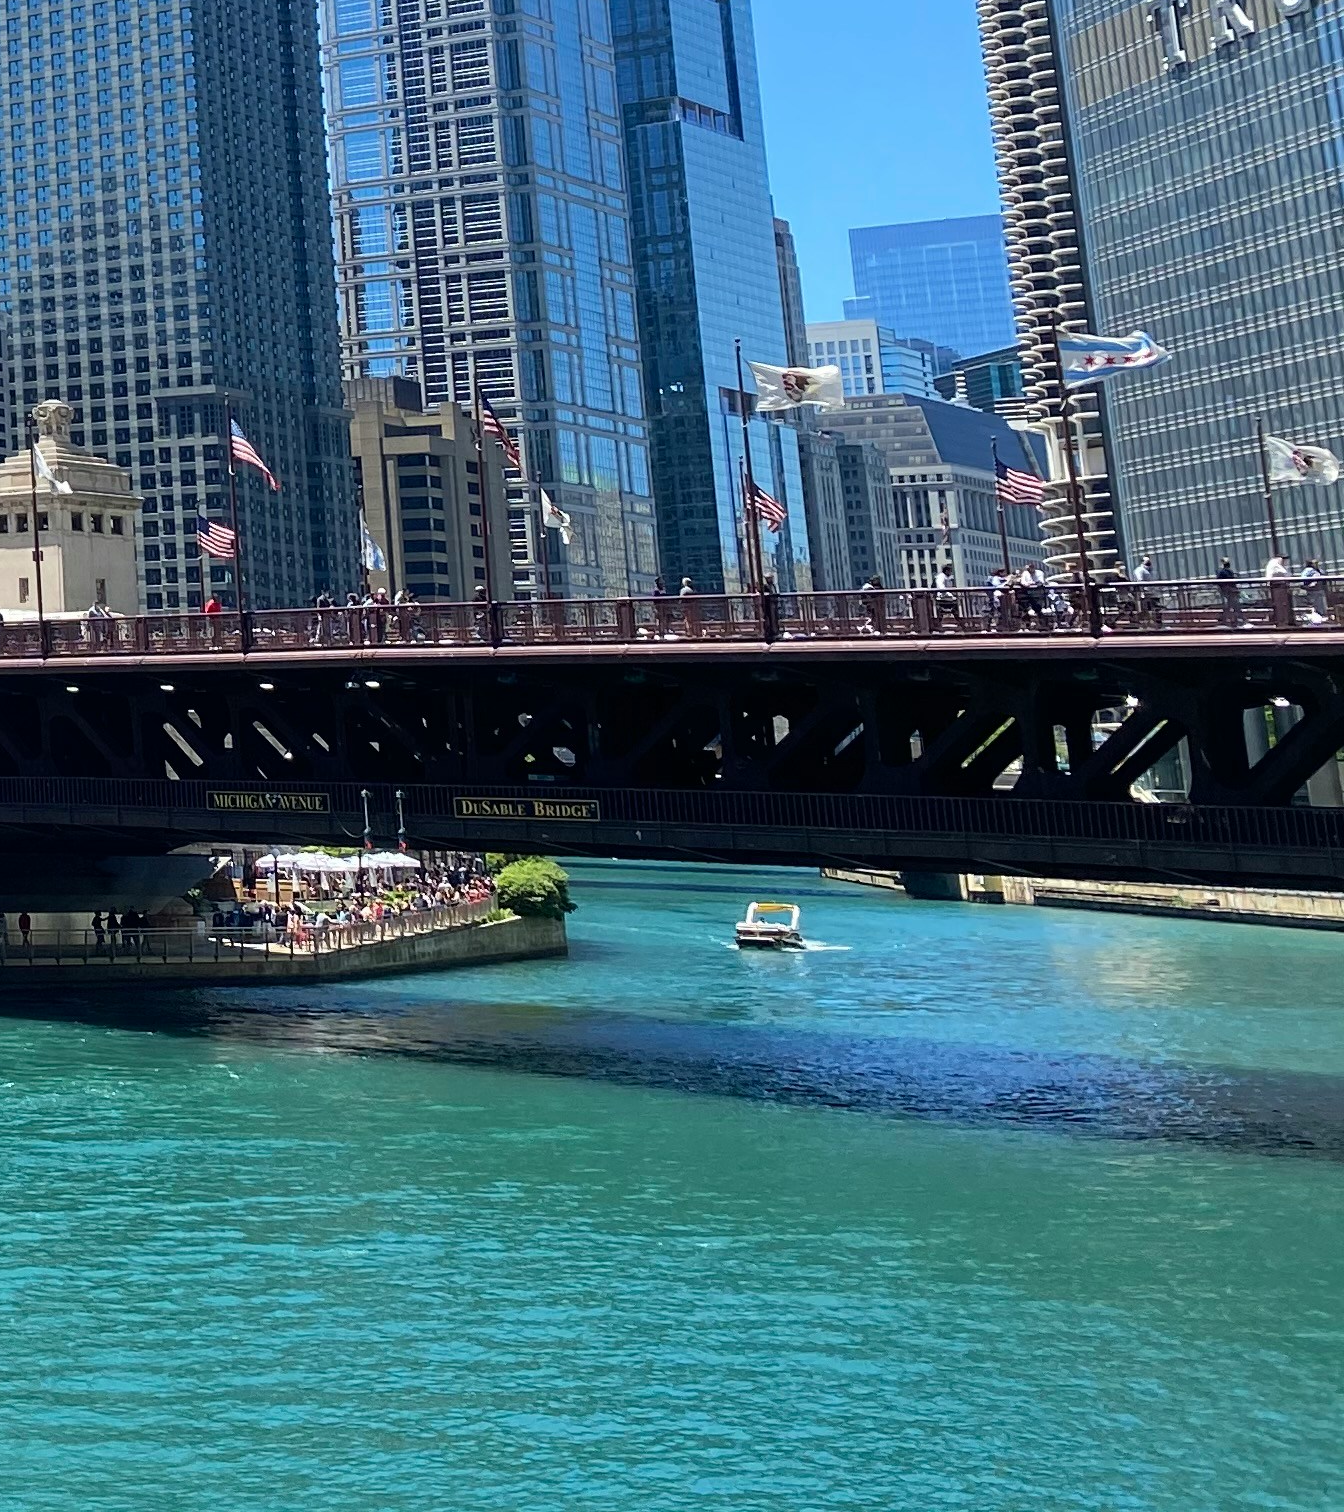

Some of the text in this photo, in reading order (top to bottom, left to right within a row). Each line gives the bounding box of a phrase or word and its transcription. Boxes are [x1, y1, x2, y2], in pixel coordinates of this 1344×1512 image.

[214, 794, 323, 810] MICHIGAN AVENUE
[533, 800, 592, 817] BRIDGE
